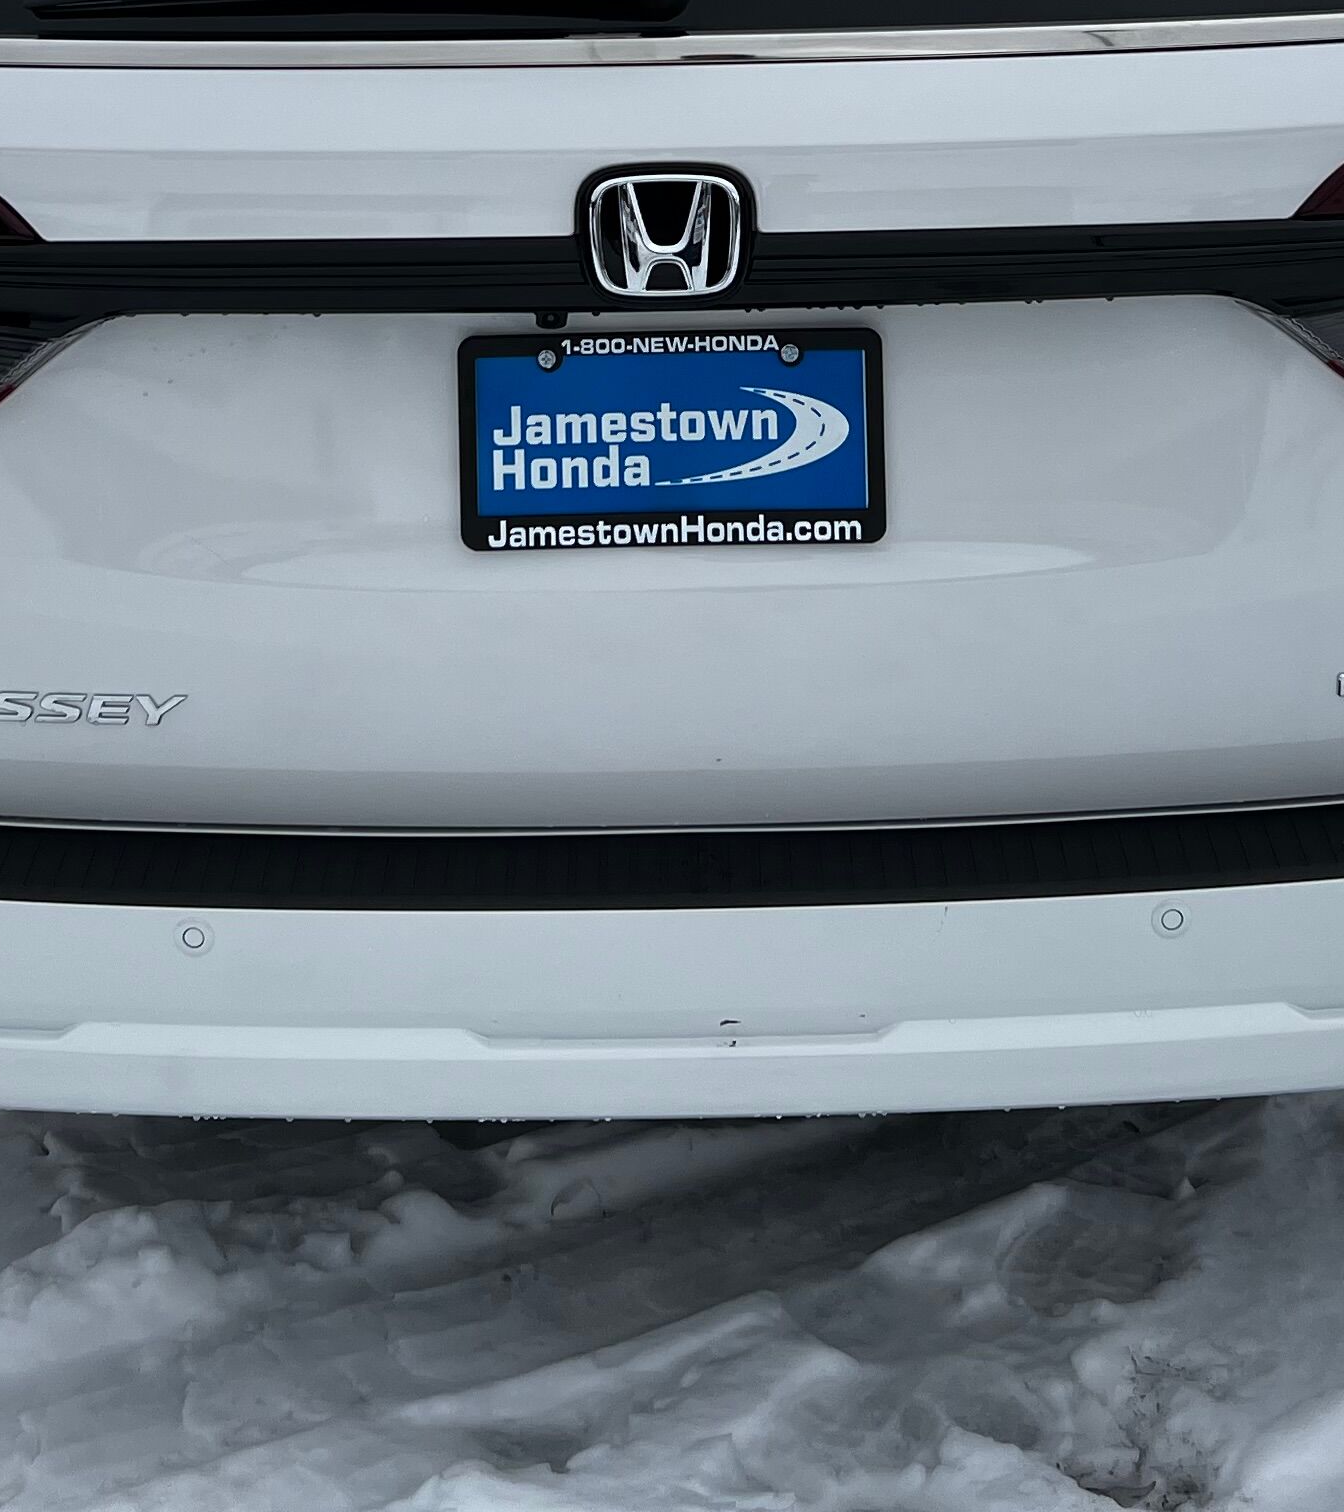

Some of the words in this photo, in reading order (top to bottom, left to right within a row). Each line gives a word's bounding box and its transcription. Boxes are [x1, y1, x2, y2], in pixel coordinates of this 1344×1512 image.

[561, 334, 779, 356] 1-800-NEW-HONDA
[493, 402, 779, 446] Jamestown
[493, 444, 651, 491] Honda
[488, 514, 862, 549] JamestownHonda.com
